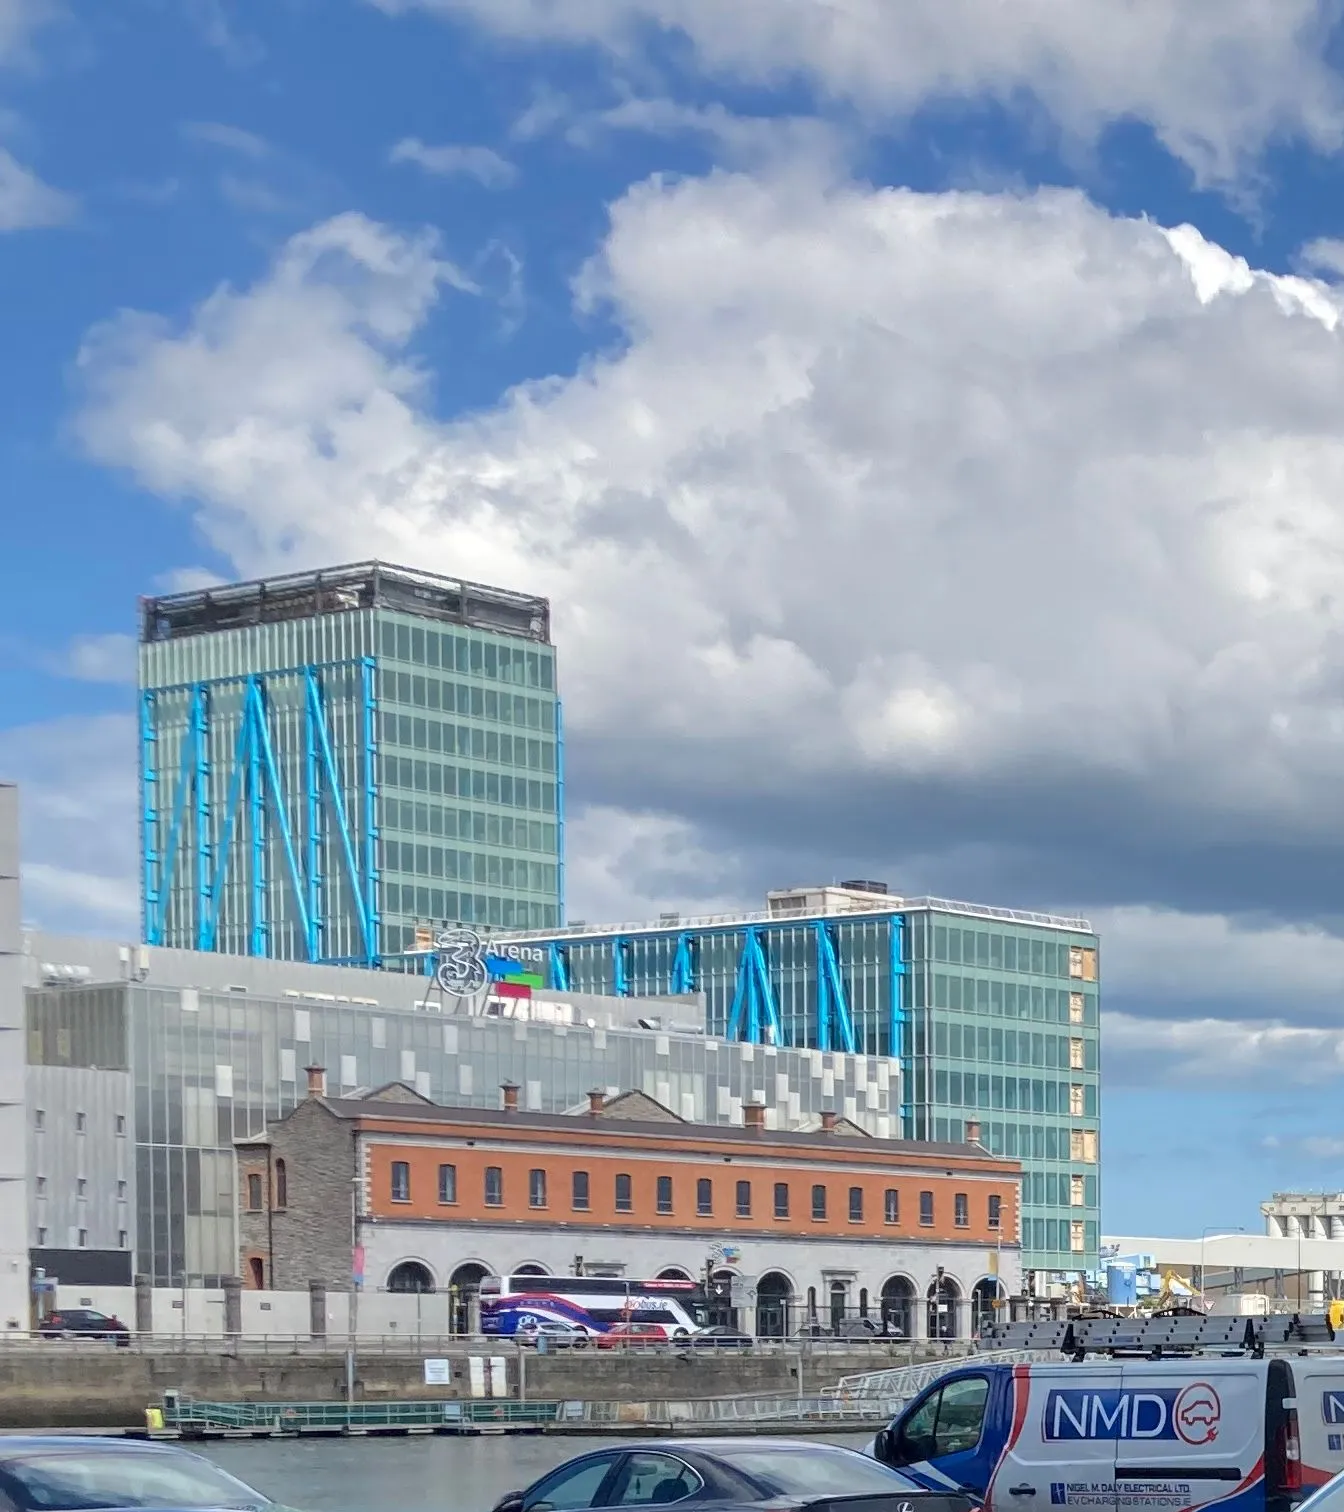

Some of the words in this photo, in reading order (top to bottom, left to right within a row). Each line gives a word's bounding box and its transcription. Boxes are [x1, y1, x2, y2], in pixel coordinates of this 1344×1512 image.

[484, 940, 544, 962] Arena
[1053, 1394, 1167, 1440] NMD
[1066, 1483, 1089, 1493] NIGEL
[1102, 1483, 1122, 1493] DALY
[1124, 1483, 1173, 1493] ELECTRICAL
